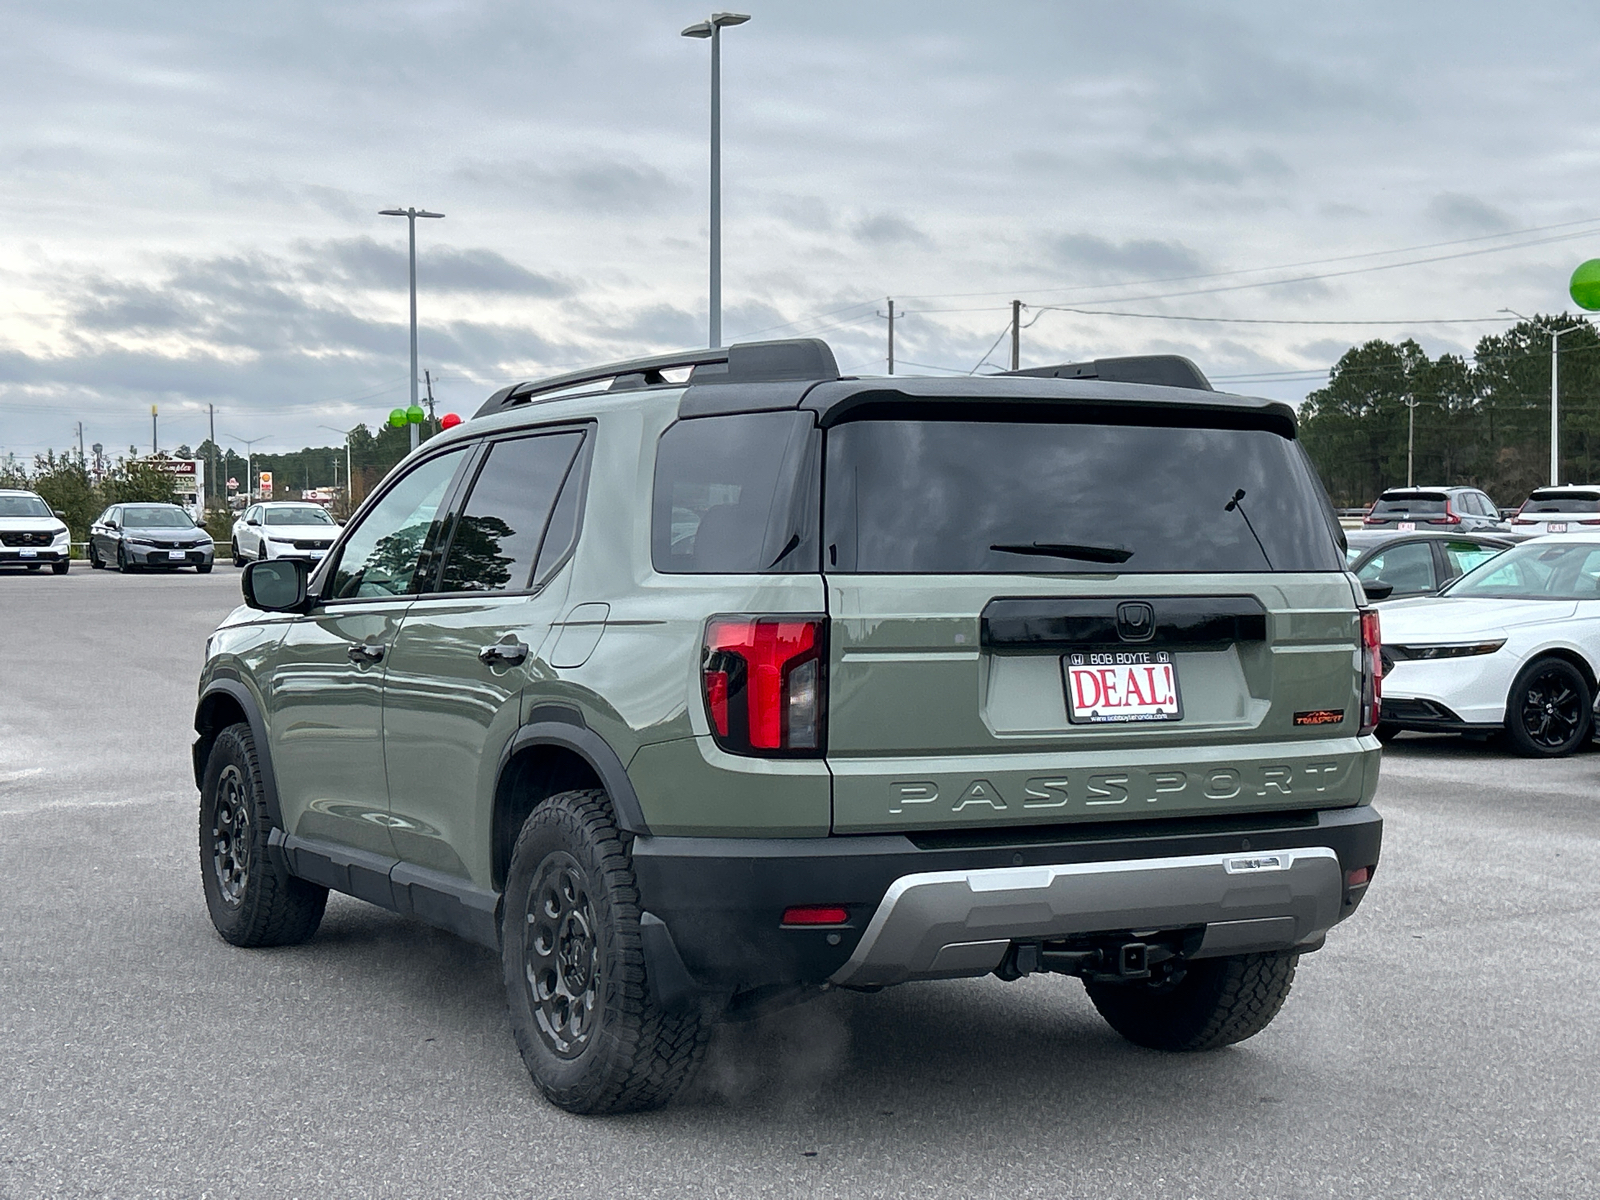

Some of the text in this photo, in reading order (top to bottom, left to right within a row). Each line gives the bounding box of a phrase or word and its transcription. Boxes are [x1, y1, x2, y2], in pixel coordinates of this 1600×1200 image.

[1090, 652, 1151, 664] BOB BOYTE
[1071, 666, 1174, 709] DEAL!
[889, 764, 1338, 813] PASSPORT
